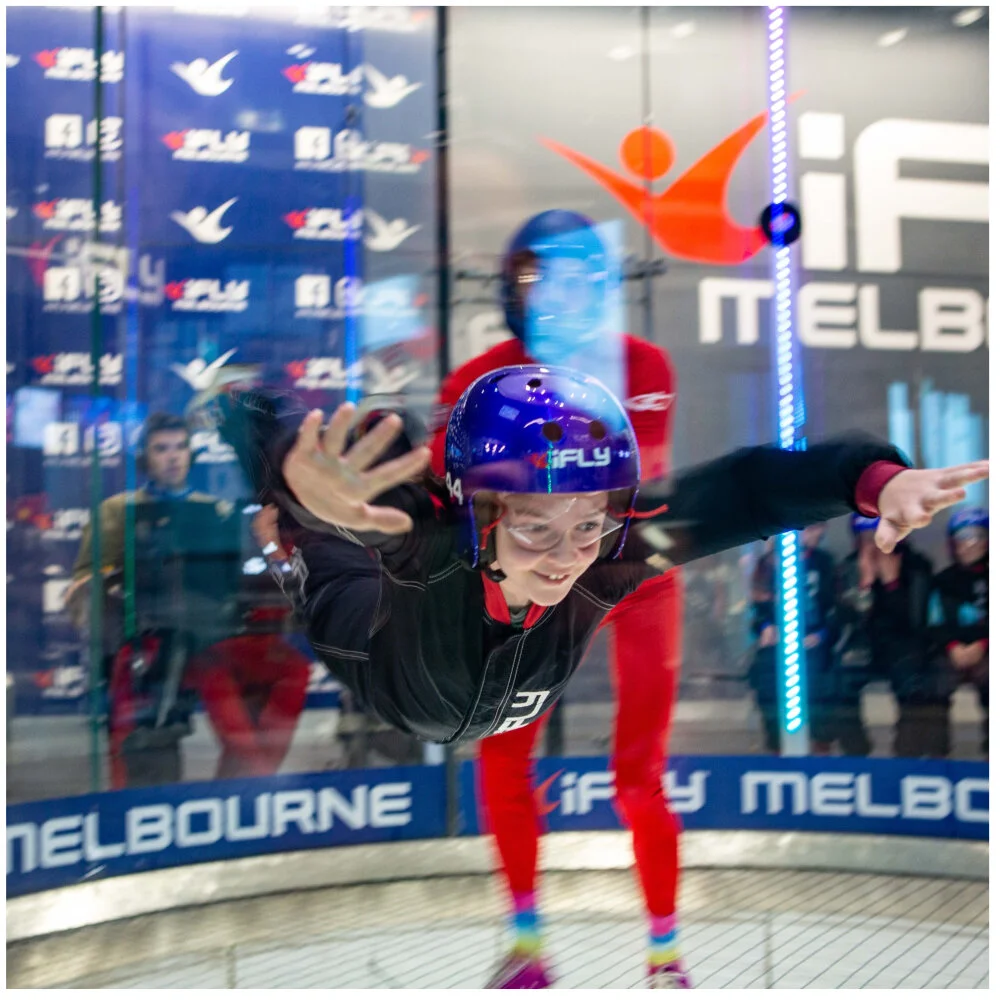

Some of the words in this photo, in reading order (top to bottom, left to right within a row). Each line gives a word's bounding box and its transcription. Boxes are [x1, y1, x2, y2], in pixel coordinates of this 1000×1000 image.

[700, 276, 989, 352] MELB
[551, 446, 611, 469] iFLY
[560, 769, 711, 815] iFY
